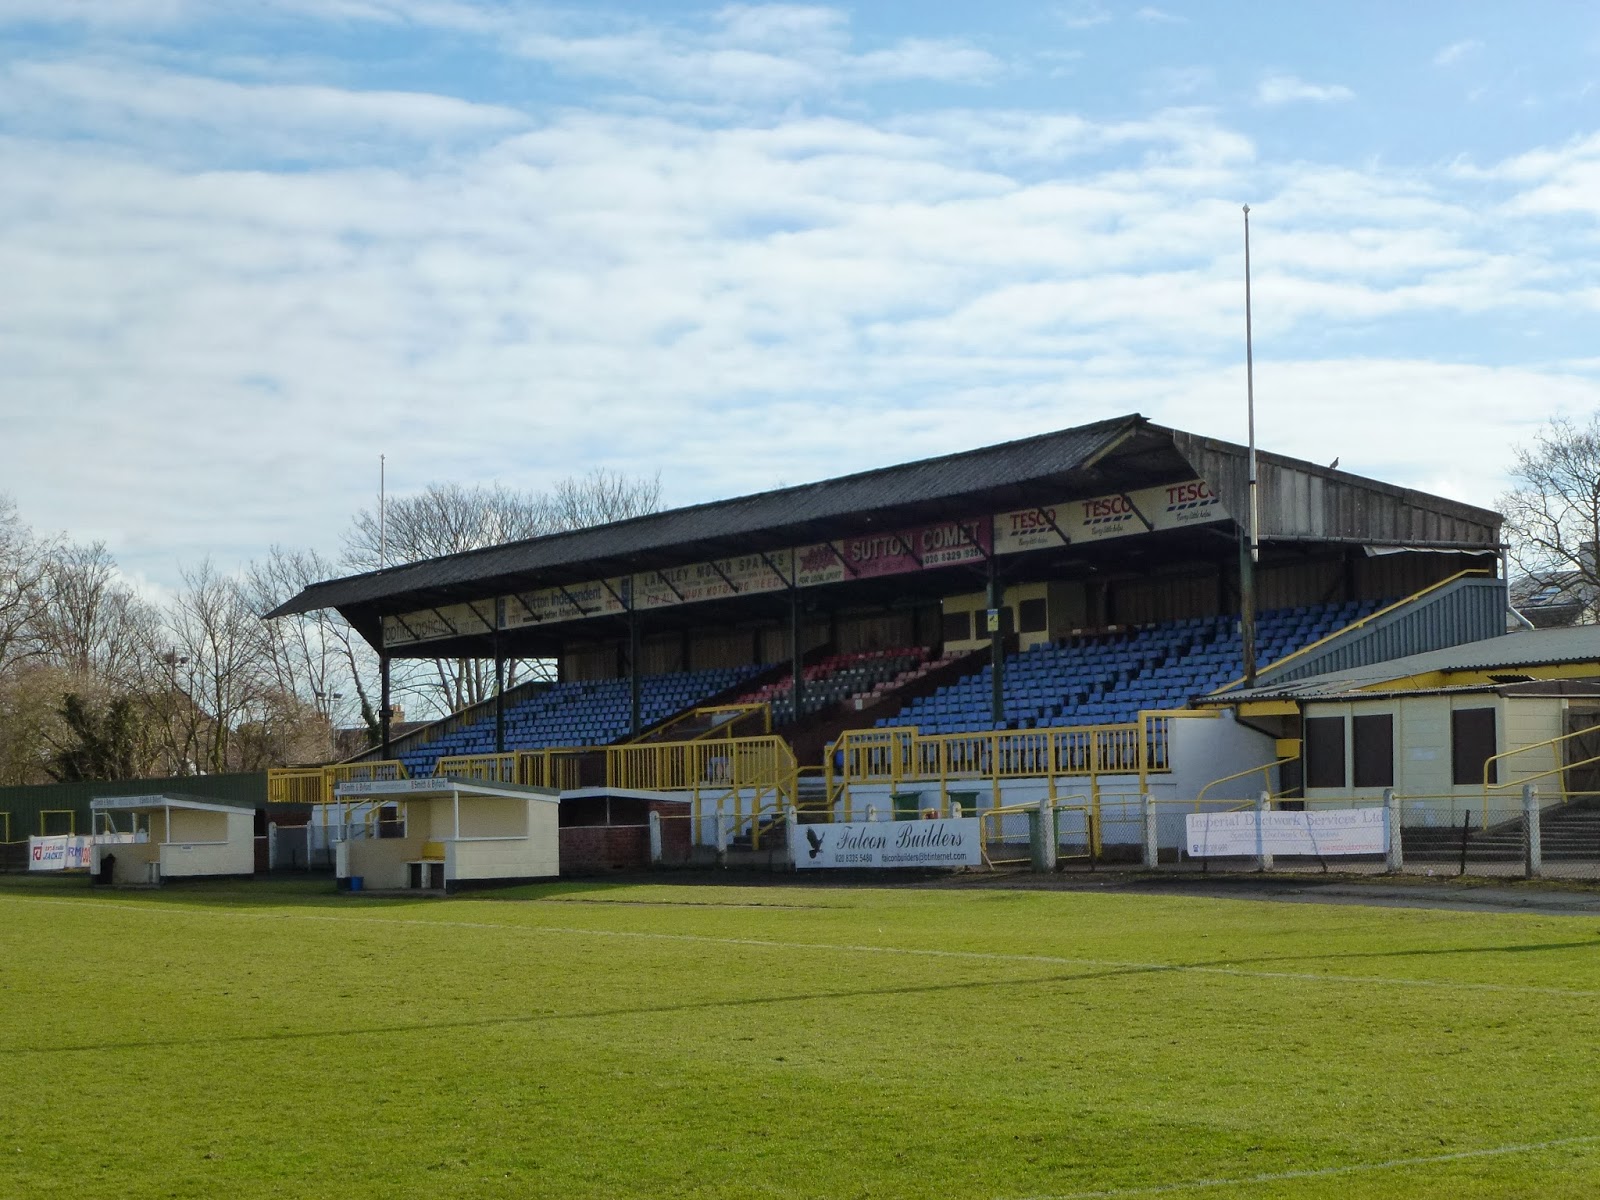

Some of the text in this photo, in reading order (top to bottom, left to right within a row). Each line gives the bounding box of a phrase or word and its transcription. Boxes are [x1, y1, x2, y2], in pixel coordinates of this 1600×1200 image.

[1010, 508, 1057, 530] TESCO
[1081, 496, 1132, 519] TESCO
[851, 534, 913, 562] SUTTON
[921, 521, 980, 549] COMET
[1306, 813, 1356, 826] Services
[836, 823, 964, 850] Falcon Builders
